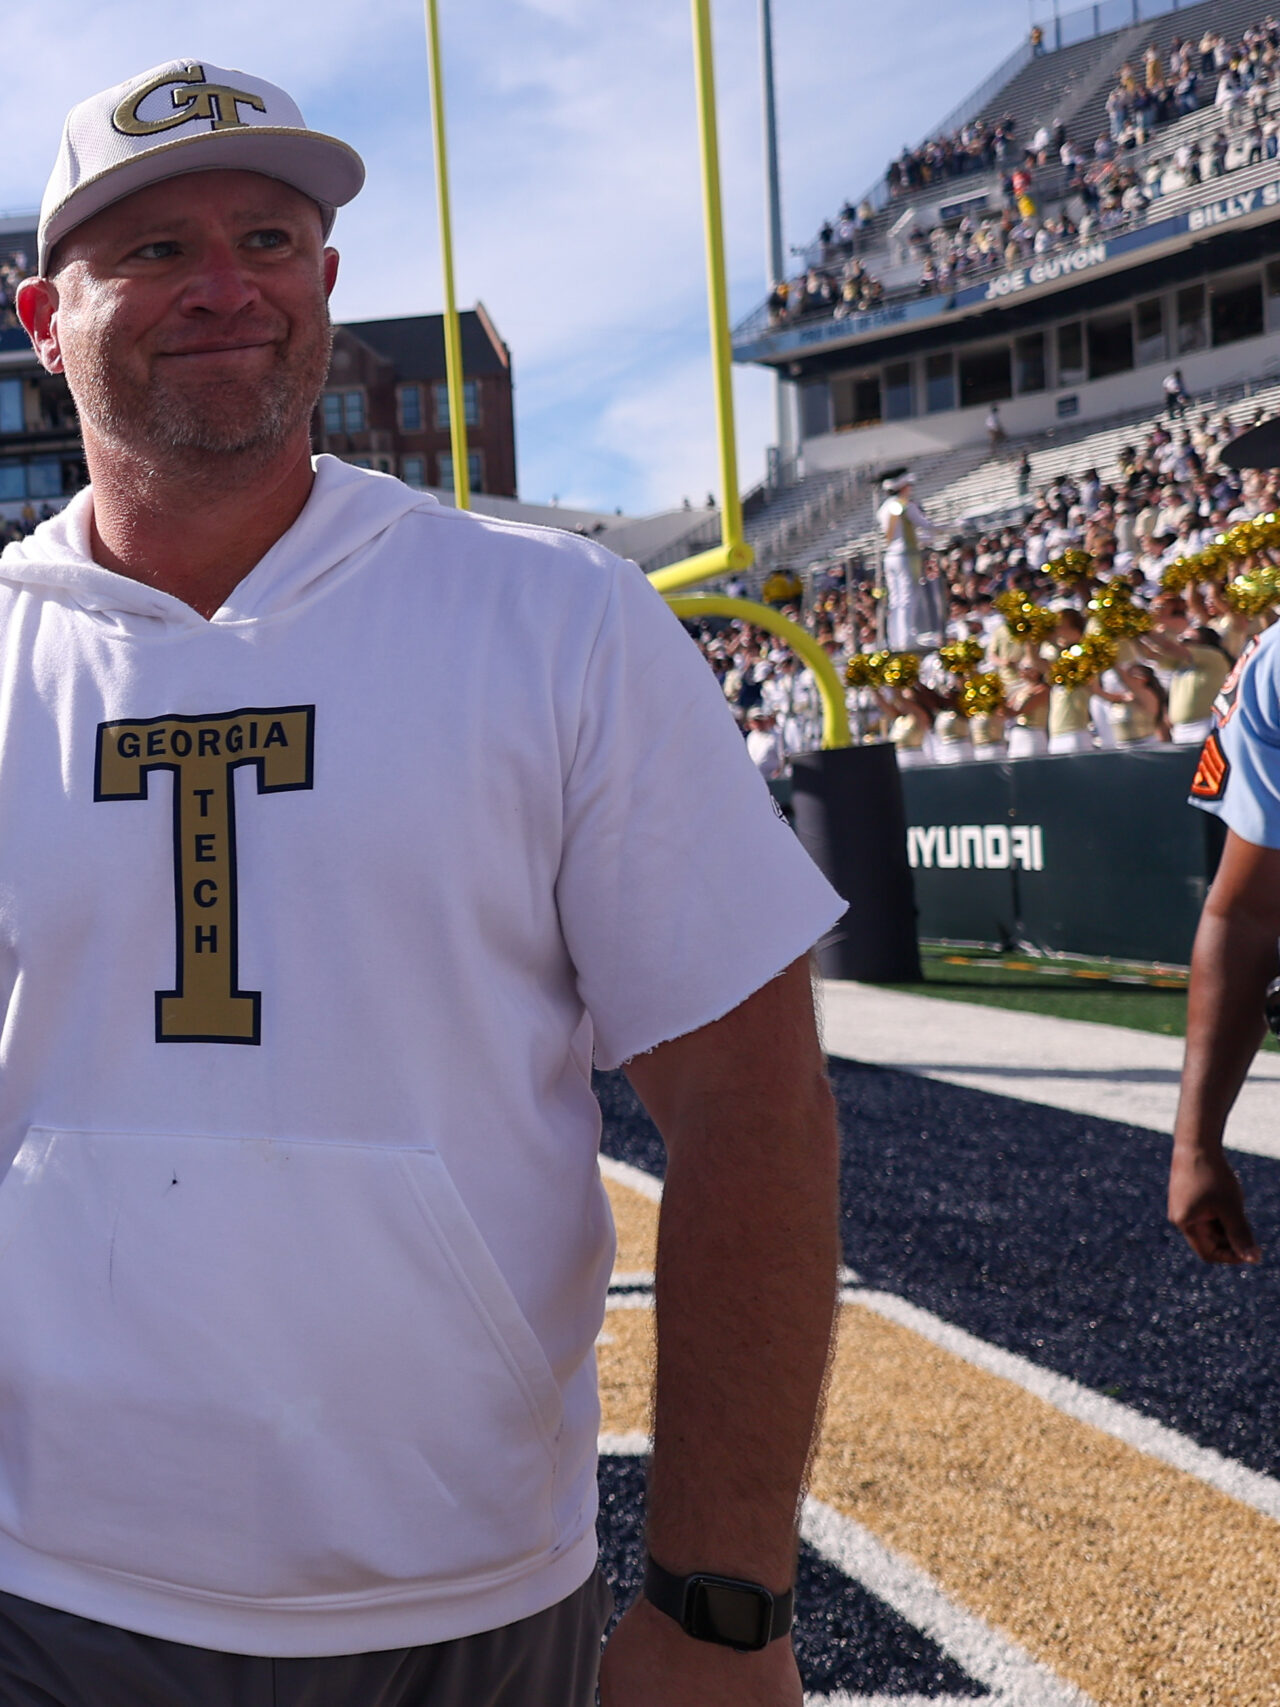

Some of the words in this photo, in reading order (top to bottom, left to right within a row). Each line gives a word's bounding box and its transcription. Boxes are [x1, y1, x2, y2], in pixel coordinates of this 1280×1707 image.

[111, 65, 267, 136] GT
[1188, 190, 1256, 231] BILLY
[1262, 182, 1280, 206] S
[985, 273, 1026, 300] JOE
[1029, 243, 1107, 285] GUYON
[117, 720, 289, 758] GEORGIA
[193, 788, 219, 954] TECH
